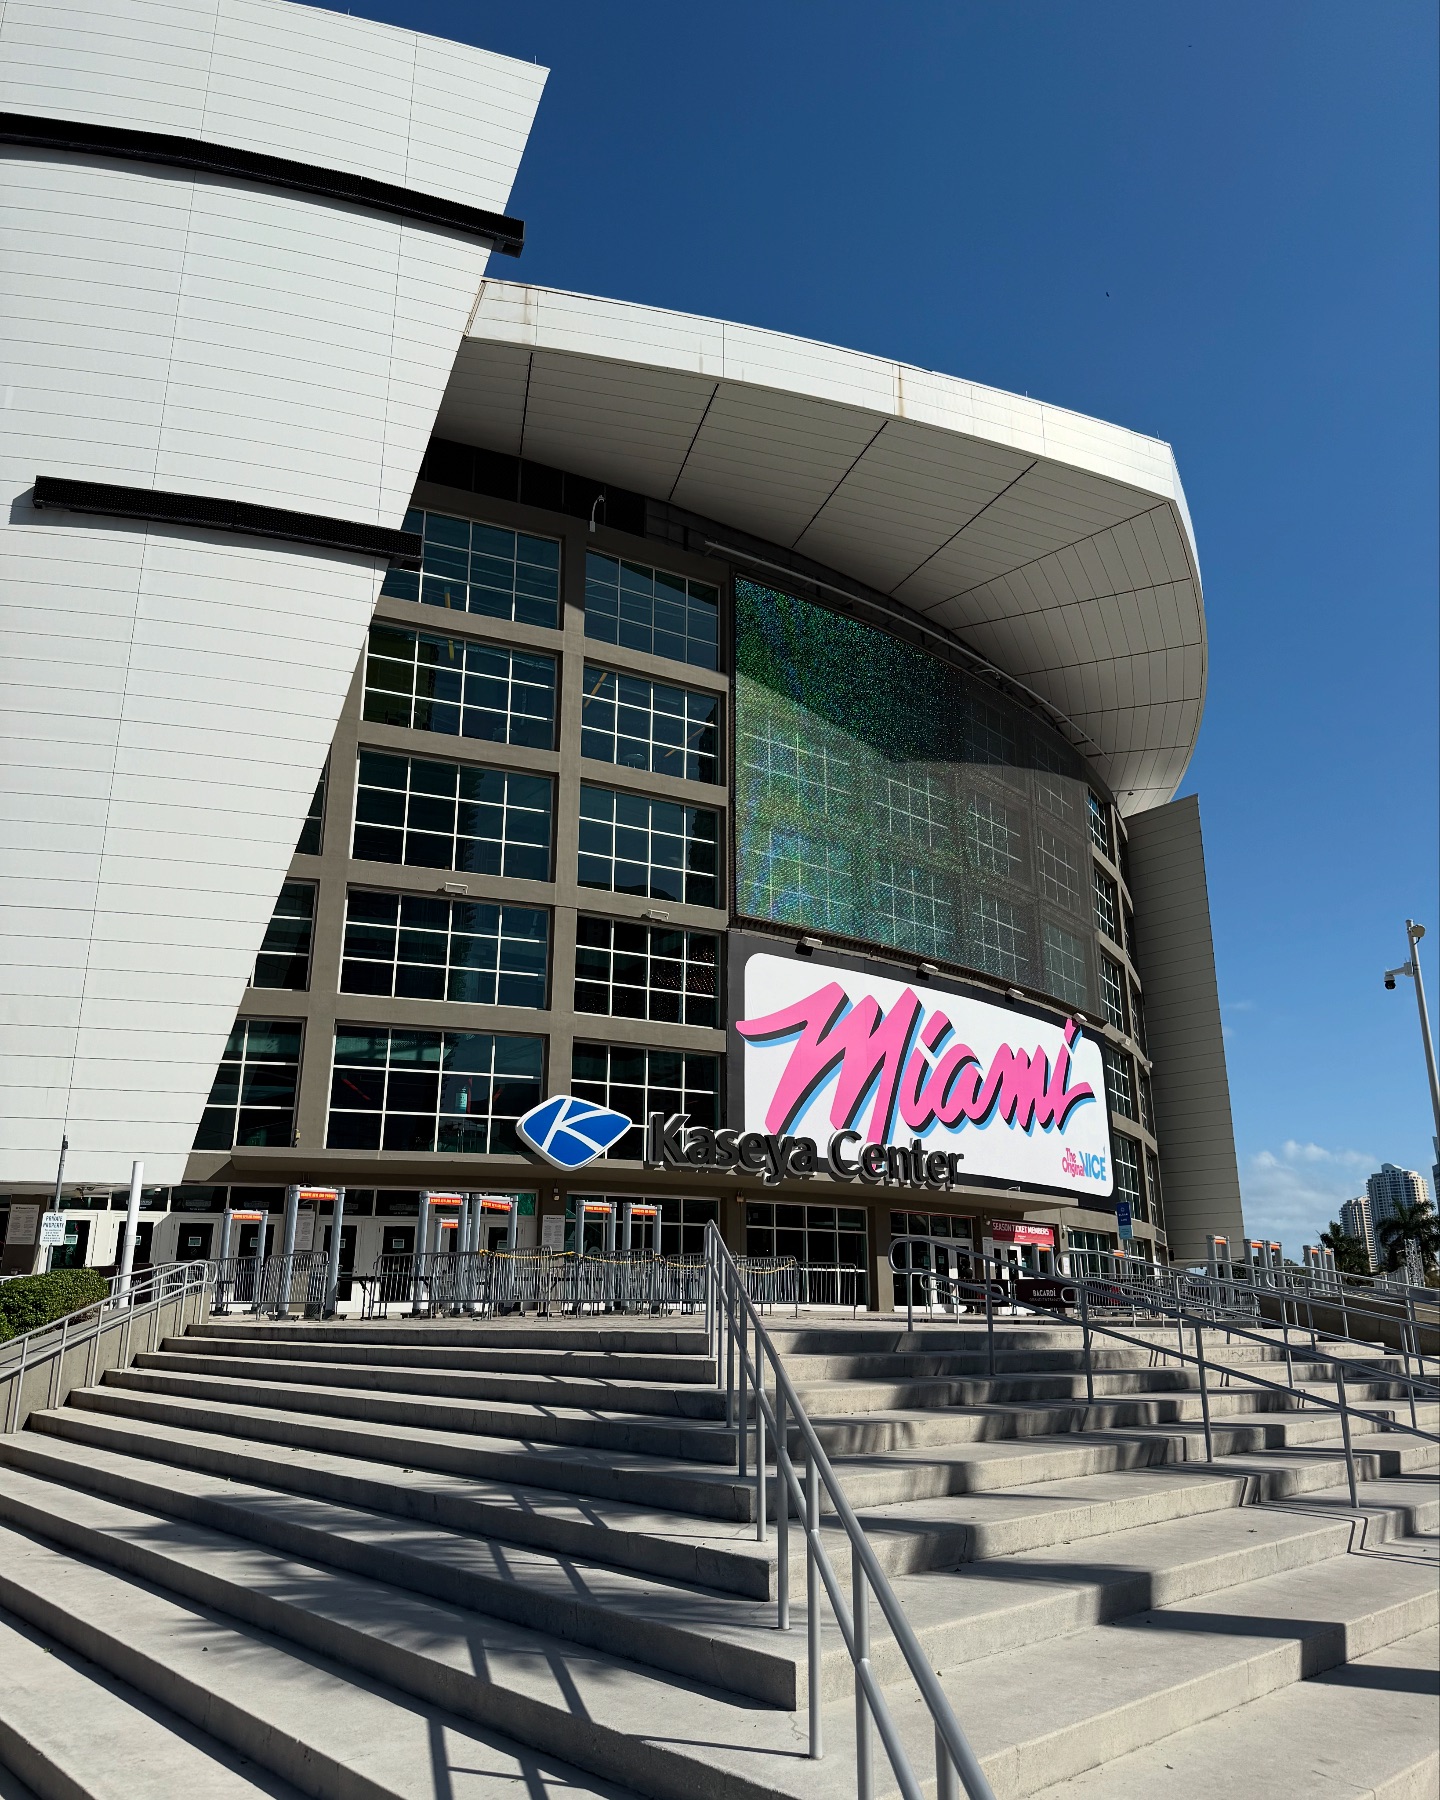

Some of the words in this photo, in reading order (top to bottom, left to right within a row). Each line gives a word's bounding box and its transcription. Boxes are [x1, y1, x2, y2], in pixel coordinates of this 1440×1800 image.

[735, 981, 1096, 1170] Miami
[647, 1111, 819, 1187] Kaseya
[827, 1128, 965, 1189] Center
[1065, 1147, 1077, 1163] The
[1062, 1156, 1085, 1178] Original
[992, 1222, 1012, 1232] SEASON
[1012, 1224, 1028, 1234] TICKET
[1028, 1226, 1050, 1236] MEMBERS
